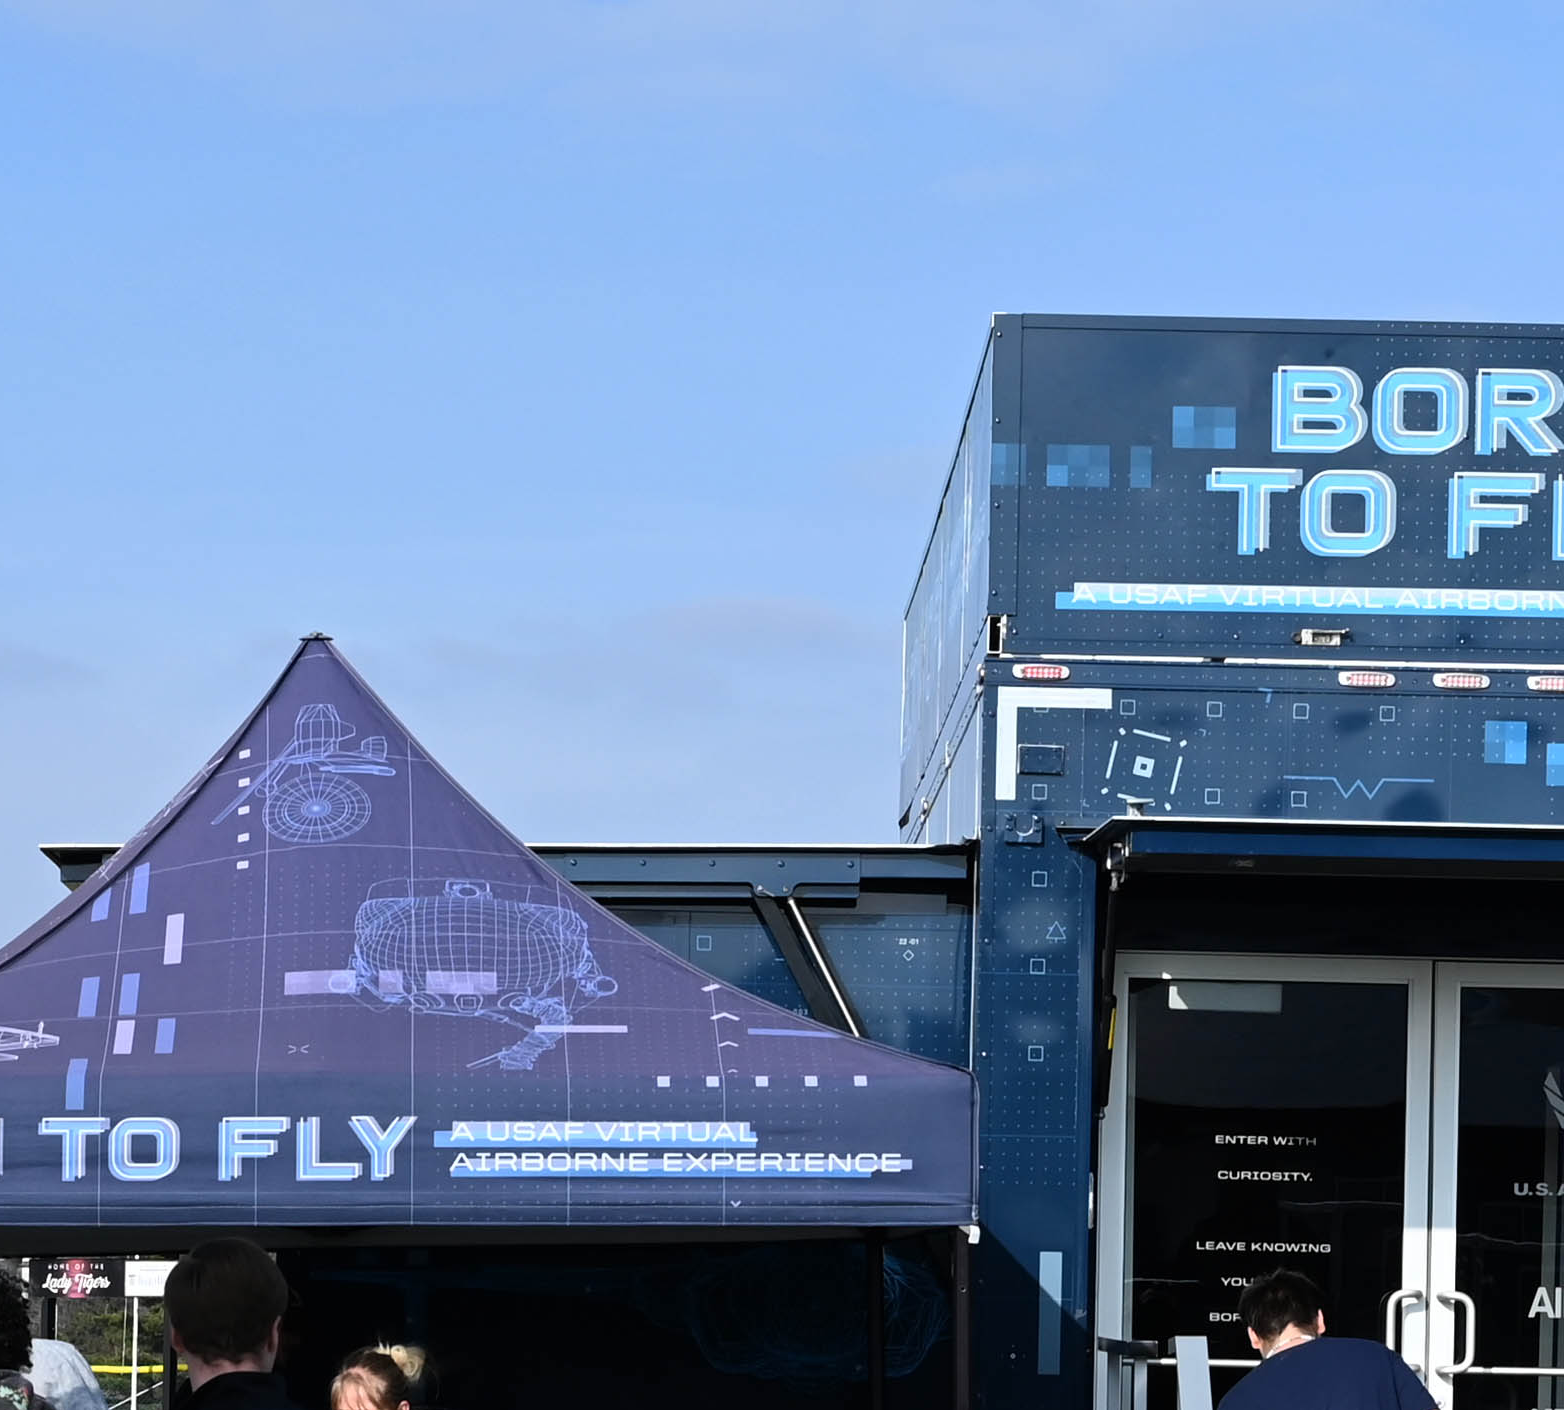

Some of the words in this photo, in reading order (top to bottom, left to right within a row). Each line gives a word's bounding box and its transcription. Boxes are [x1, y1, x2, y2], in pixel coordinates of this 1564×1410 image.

[1206, 467, 1396, 557] TO
[1073, 584, 1098, 604] A
[1107, 585, 1209, 606] USAF
[1219, 587, 1384, 609] VIRTUAL
[450, 1122, 473, 1142] A
[496, 1122, 585, 1142] USAF
[596, 1122, 758, 1143] VIRTUAL
[1215, 1135, 1268, 1145] ENTER
[1273, 1136, 1317, 1146] WITH
[39, 1117, 180, 1182] TO
[218, 1115, 417, 1181] FLY
[450, 1152, 649, 1173] AIRBORNE
[662, 1152, 902, 1173] EXPERIENCE
[1217, 1170, 1313, 1182] CURIOSITY.
[1513, 1183, 1553, 1197] U.S.
[1196, 1241, 1246, 1251] LEAVE
[1251, 1242, 1331, 1253] KNOWING
[42, 1273, 72, 1294] Lady
[75, 1273, 111, 1294] Tigers
[1221, 1277, 1254, 1287] YOU
[1209, 1312, 1243, 1322] BOR
